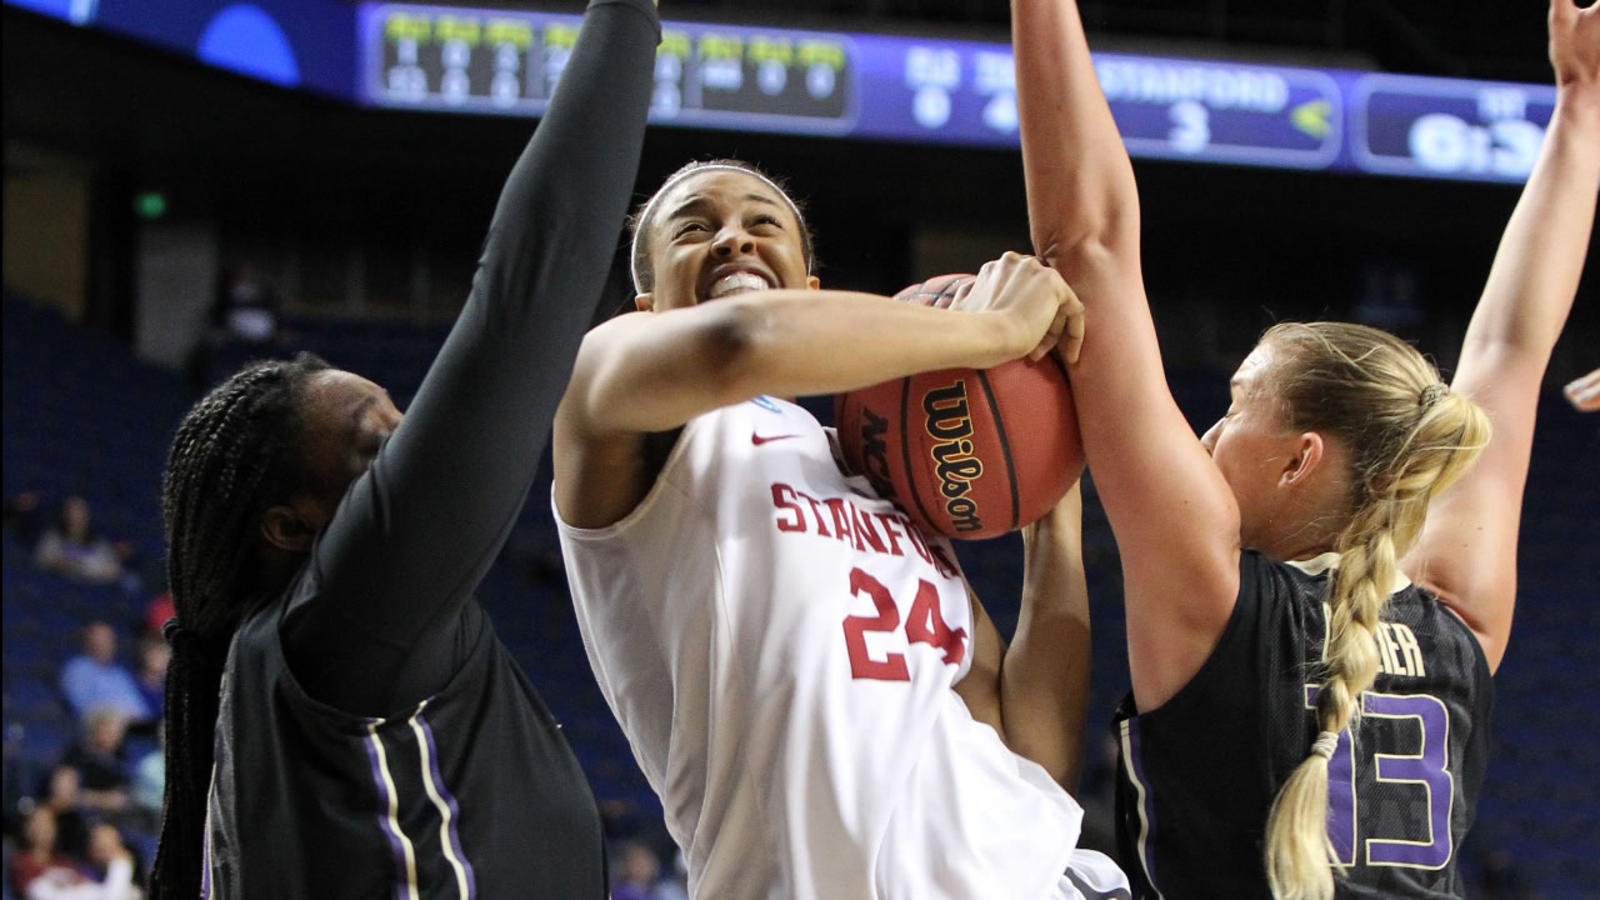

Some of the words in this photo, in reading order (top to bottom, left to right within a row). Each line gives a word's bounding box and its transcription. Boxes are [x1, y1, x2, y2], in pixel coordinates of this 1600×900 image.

[1097, 61, 1288, 113] STANFORD
[921, 379, 984, 532] Wilson
[842, 567, 968, 682] 24
